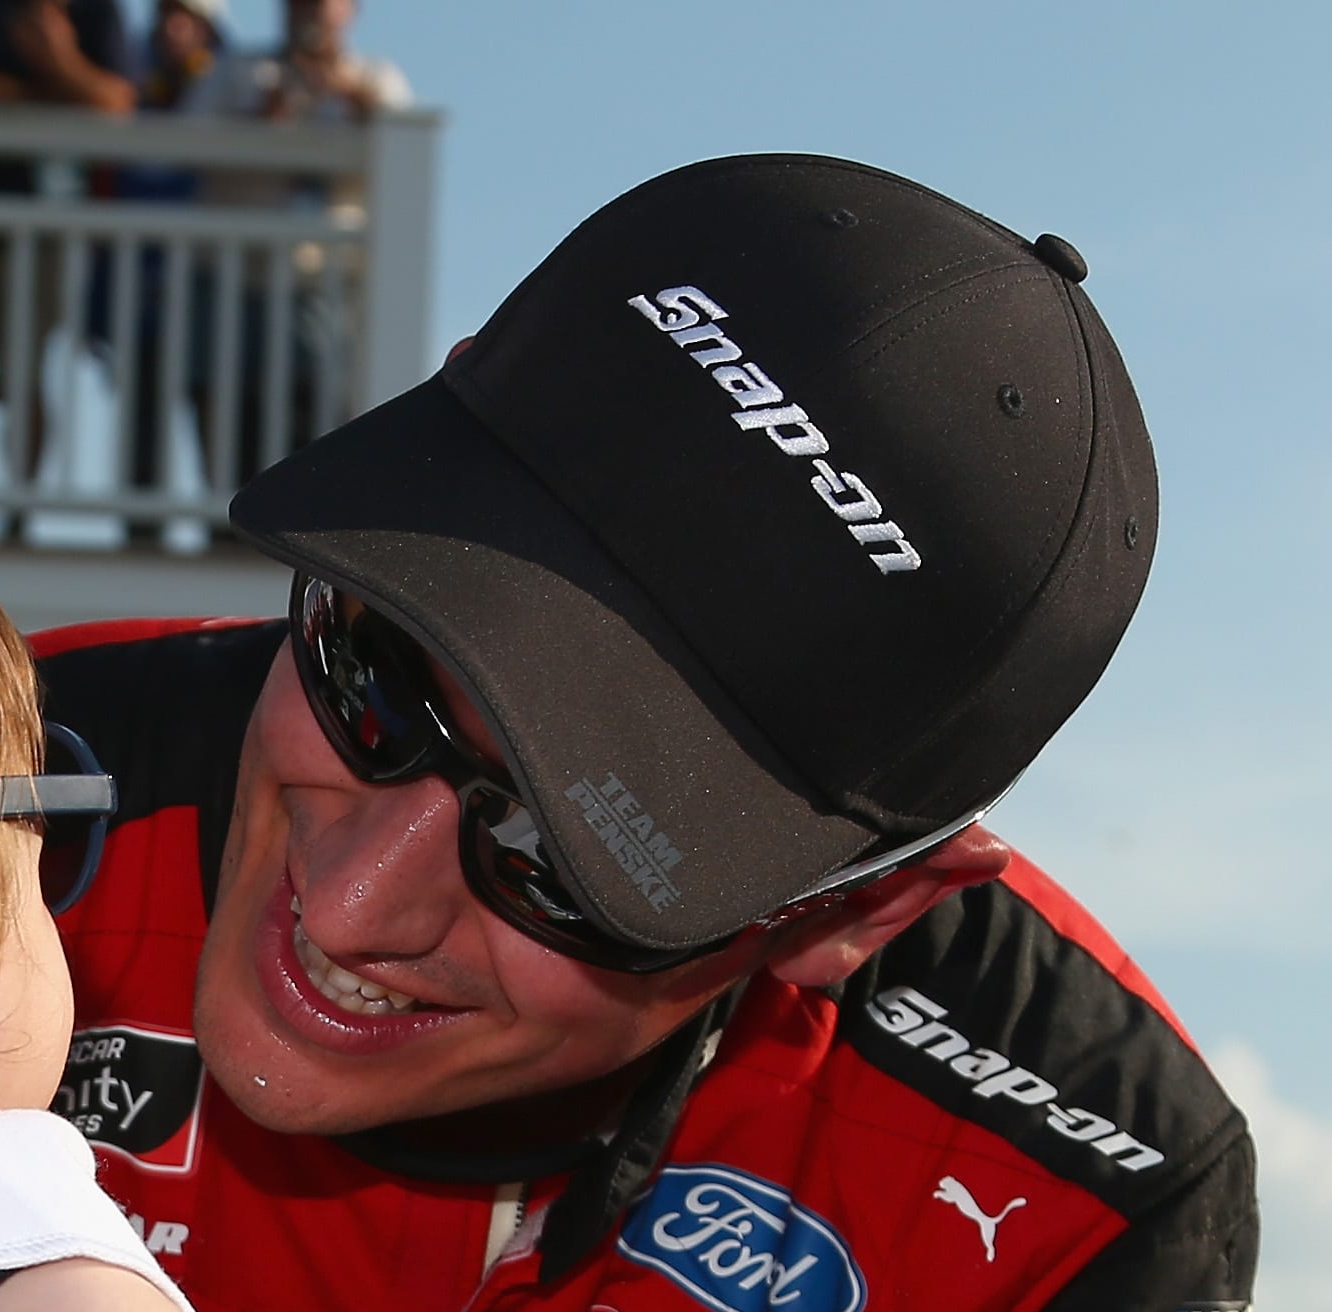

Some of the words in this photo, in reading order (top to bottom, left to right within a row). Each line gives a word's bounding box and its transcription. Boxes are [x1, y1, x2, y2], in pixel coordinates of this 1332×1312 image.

[627, 286, 921, 574] Snap-on
[564, 782, 675, 914] PENSKE
[600, 771, 682, 871] TEAM
[57, 1066, 154, 1130] nity
[72, 1036, 126, 1063] CAR
[866, 986, 1166, 1170] Snap-on
[652, 1183, 819, 1306] Ford
